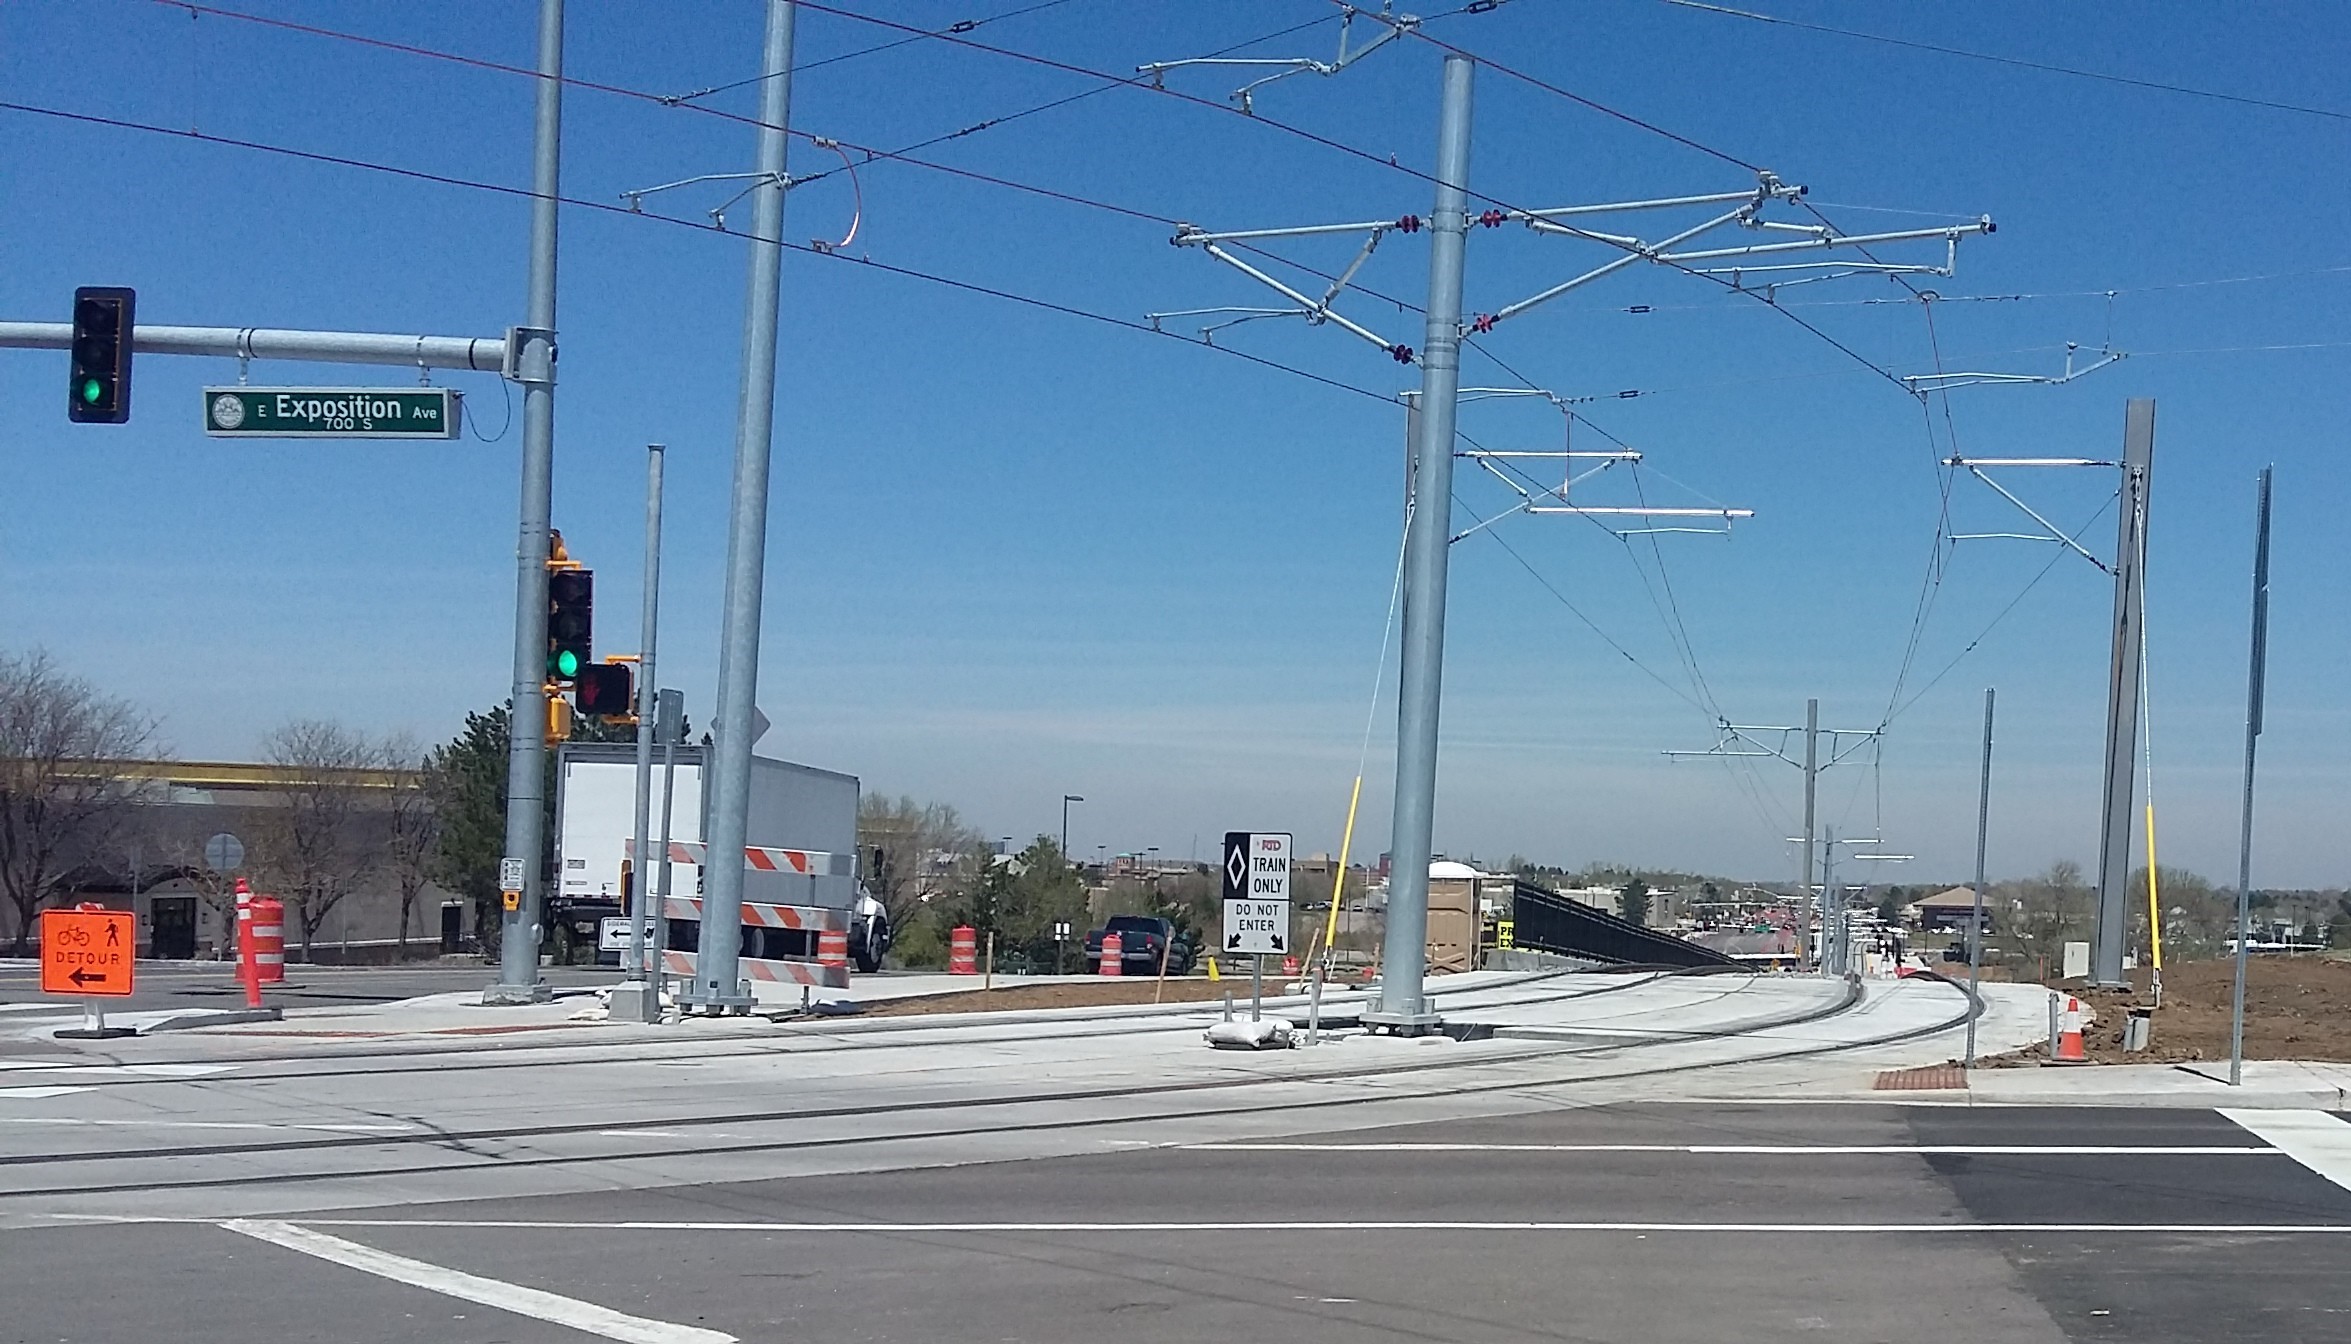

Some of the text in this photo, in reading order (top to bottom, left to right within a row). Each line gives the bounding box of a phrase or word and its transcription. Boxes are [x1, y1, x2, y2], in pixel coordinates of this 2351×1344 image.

[257, 394, 437, 422] E Exposition Ave
[323, 417, 373, 430] 700 S
[1262, 840, 1281, 851] RTD
[1253, 857, 1286, 872] TRAIN
[1253, 878, 1283, 893] ONLY
[1236, 904, 1279, 915] DO NOT
[1239, 919, 1275, 931] ENTER
[56, 951, 120, 965] DETOUR
